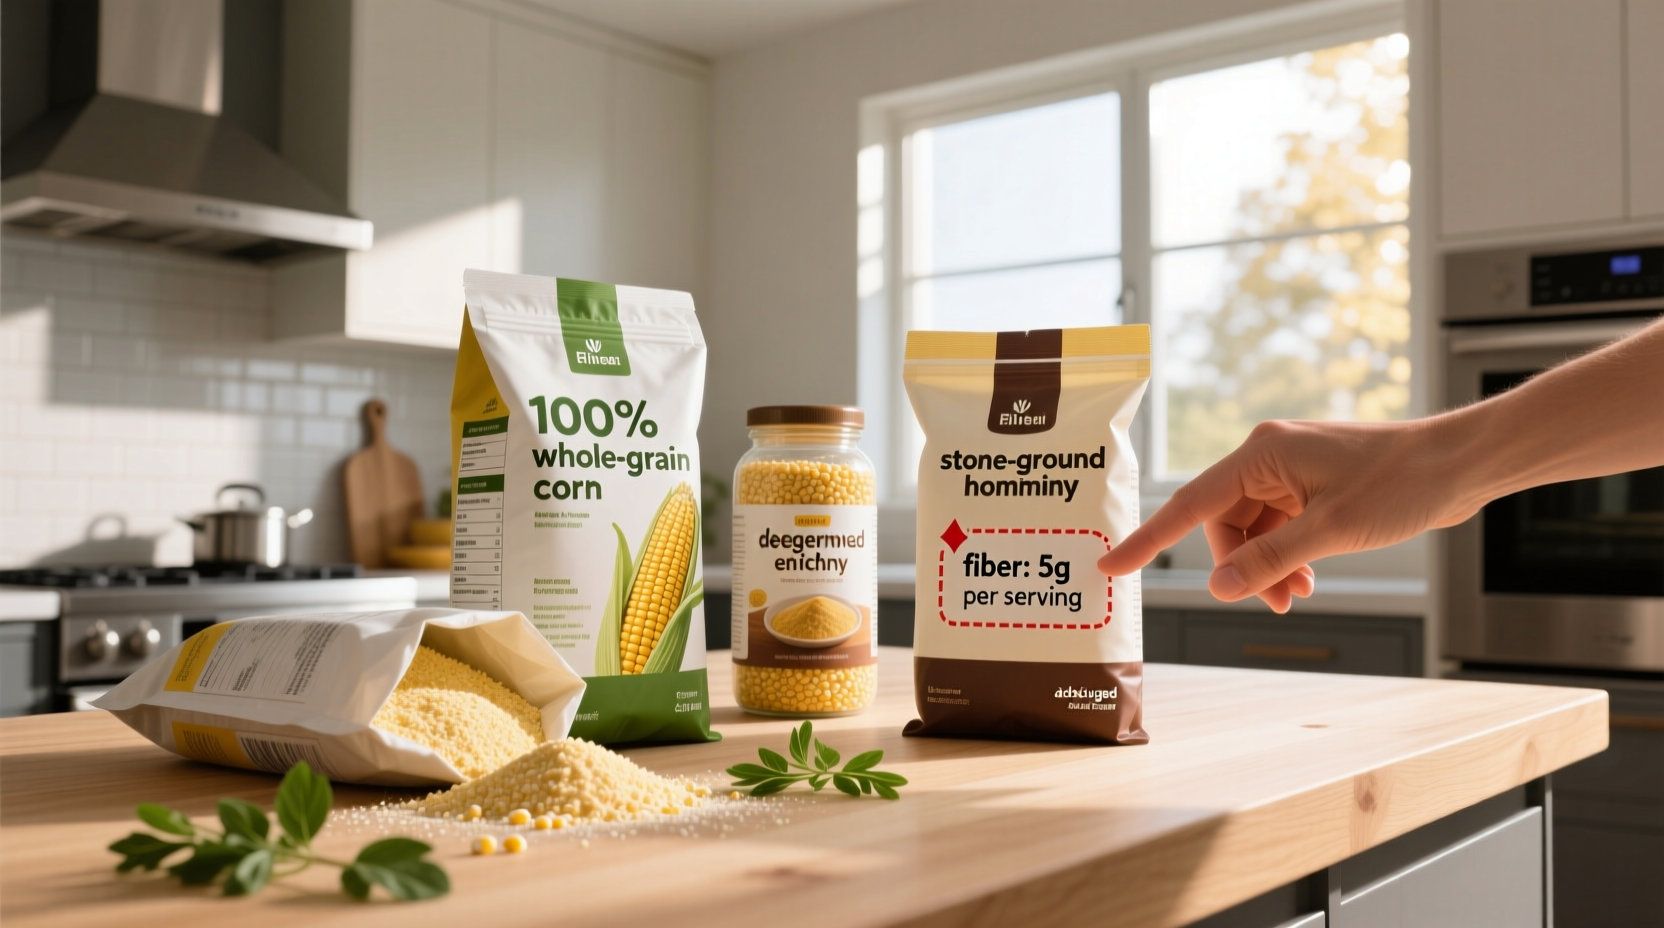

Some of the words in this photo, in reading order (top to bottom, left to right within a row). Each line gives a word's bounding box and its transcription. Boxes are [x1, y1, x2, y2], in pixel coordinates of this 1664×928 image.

[529, 395, 658, 438] 100%
[531, 441, 691, 477] whole-grain
[940, 446, 1106, 476] stone-ground
[533, 479, 602, 500] corn
[963, 552, 1030, 578] fiber:
[1038, 554, 1071, 585] 5g
[963, 589, 999, 610] per
[1004, 586, 1082, 613] serving
